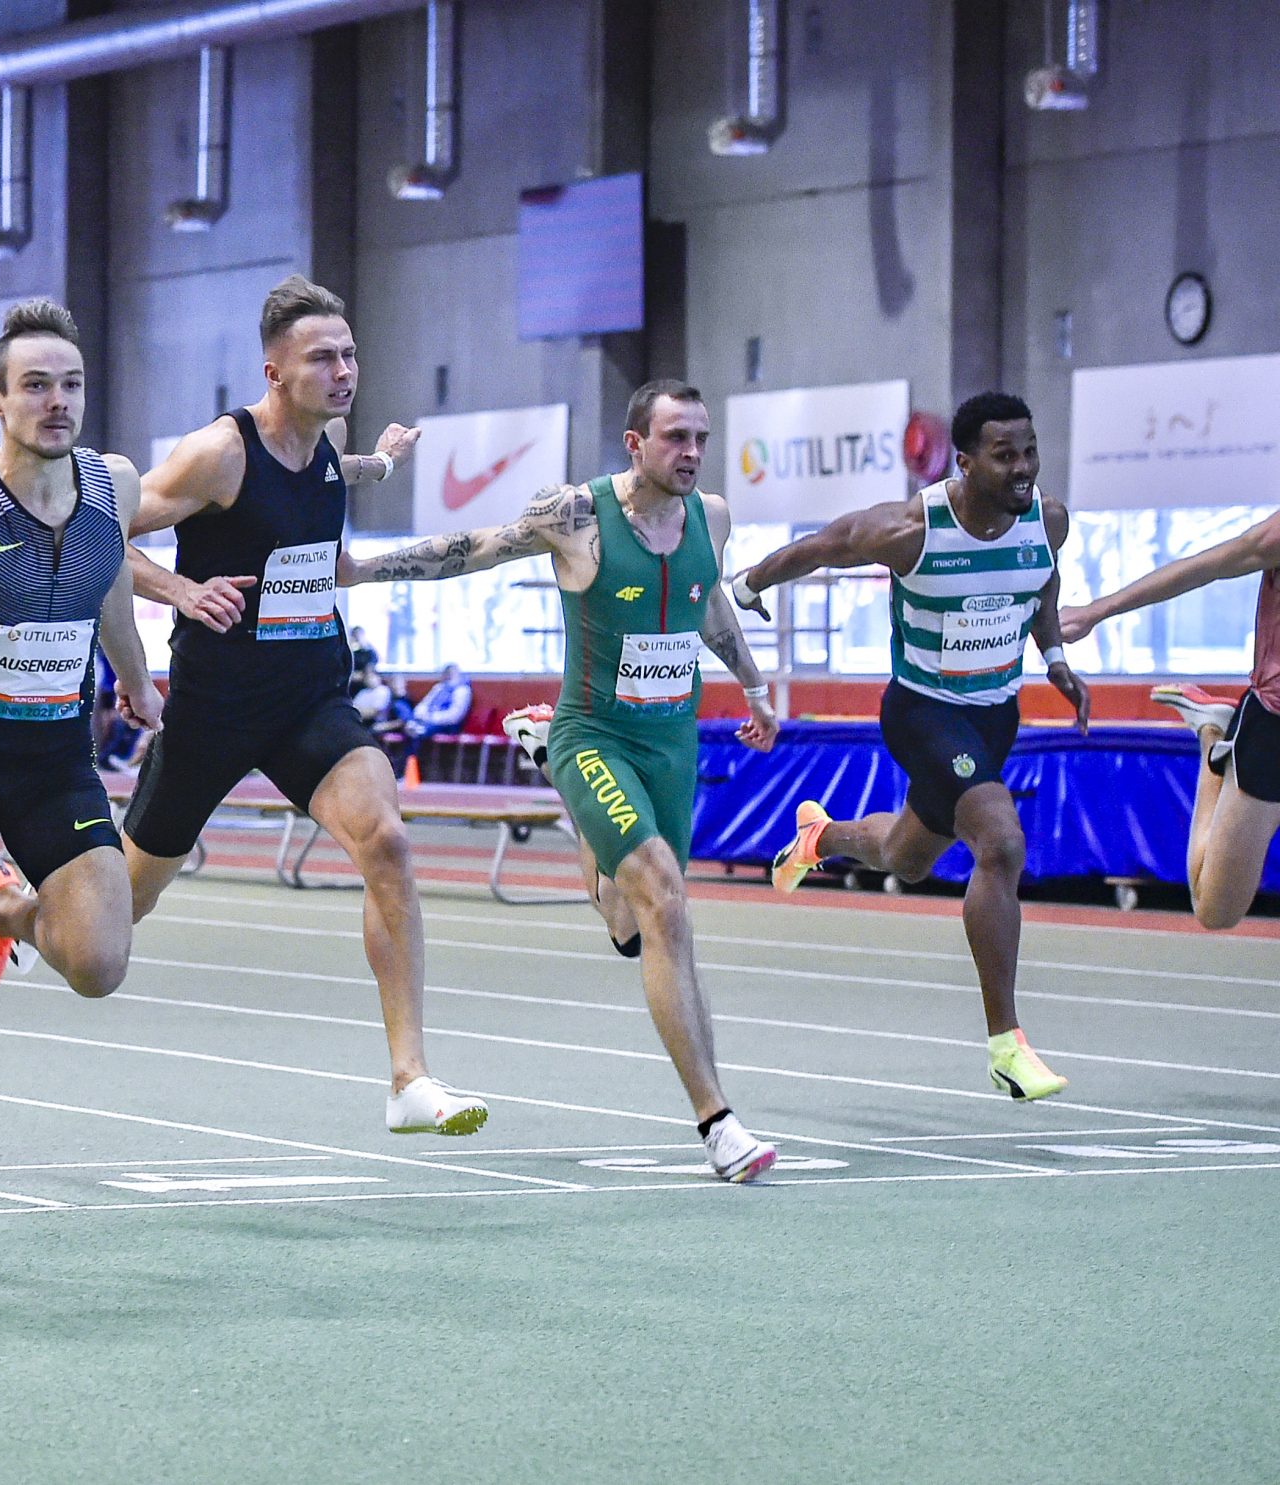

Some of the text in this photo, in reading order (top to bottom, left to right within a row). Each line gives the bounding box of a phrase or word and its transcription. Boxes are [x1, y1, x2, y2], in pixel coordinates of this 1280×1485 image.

[773, 430, 894, 479] UTILITAS
[293, 551, 328, 564] UTILITAS
[932, 557, 971, 568] macron
[261, 576, 333, 595] ROSENBERG
[616, 586, 644, 601] 4F
[971, 613, 1011, 627] UTILITAS
[24, 629, 77, 642] UTILITAS
[943, 631, 1017, 652] LARRINAGA
[650, 640, 691, 651] UTILITAS
[619, 660, 693, 680] SAVICKAS
[576, 749, 639, 836] LIETUVA
